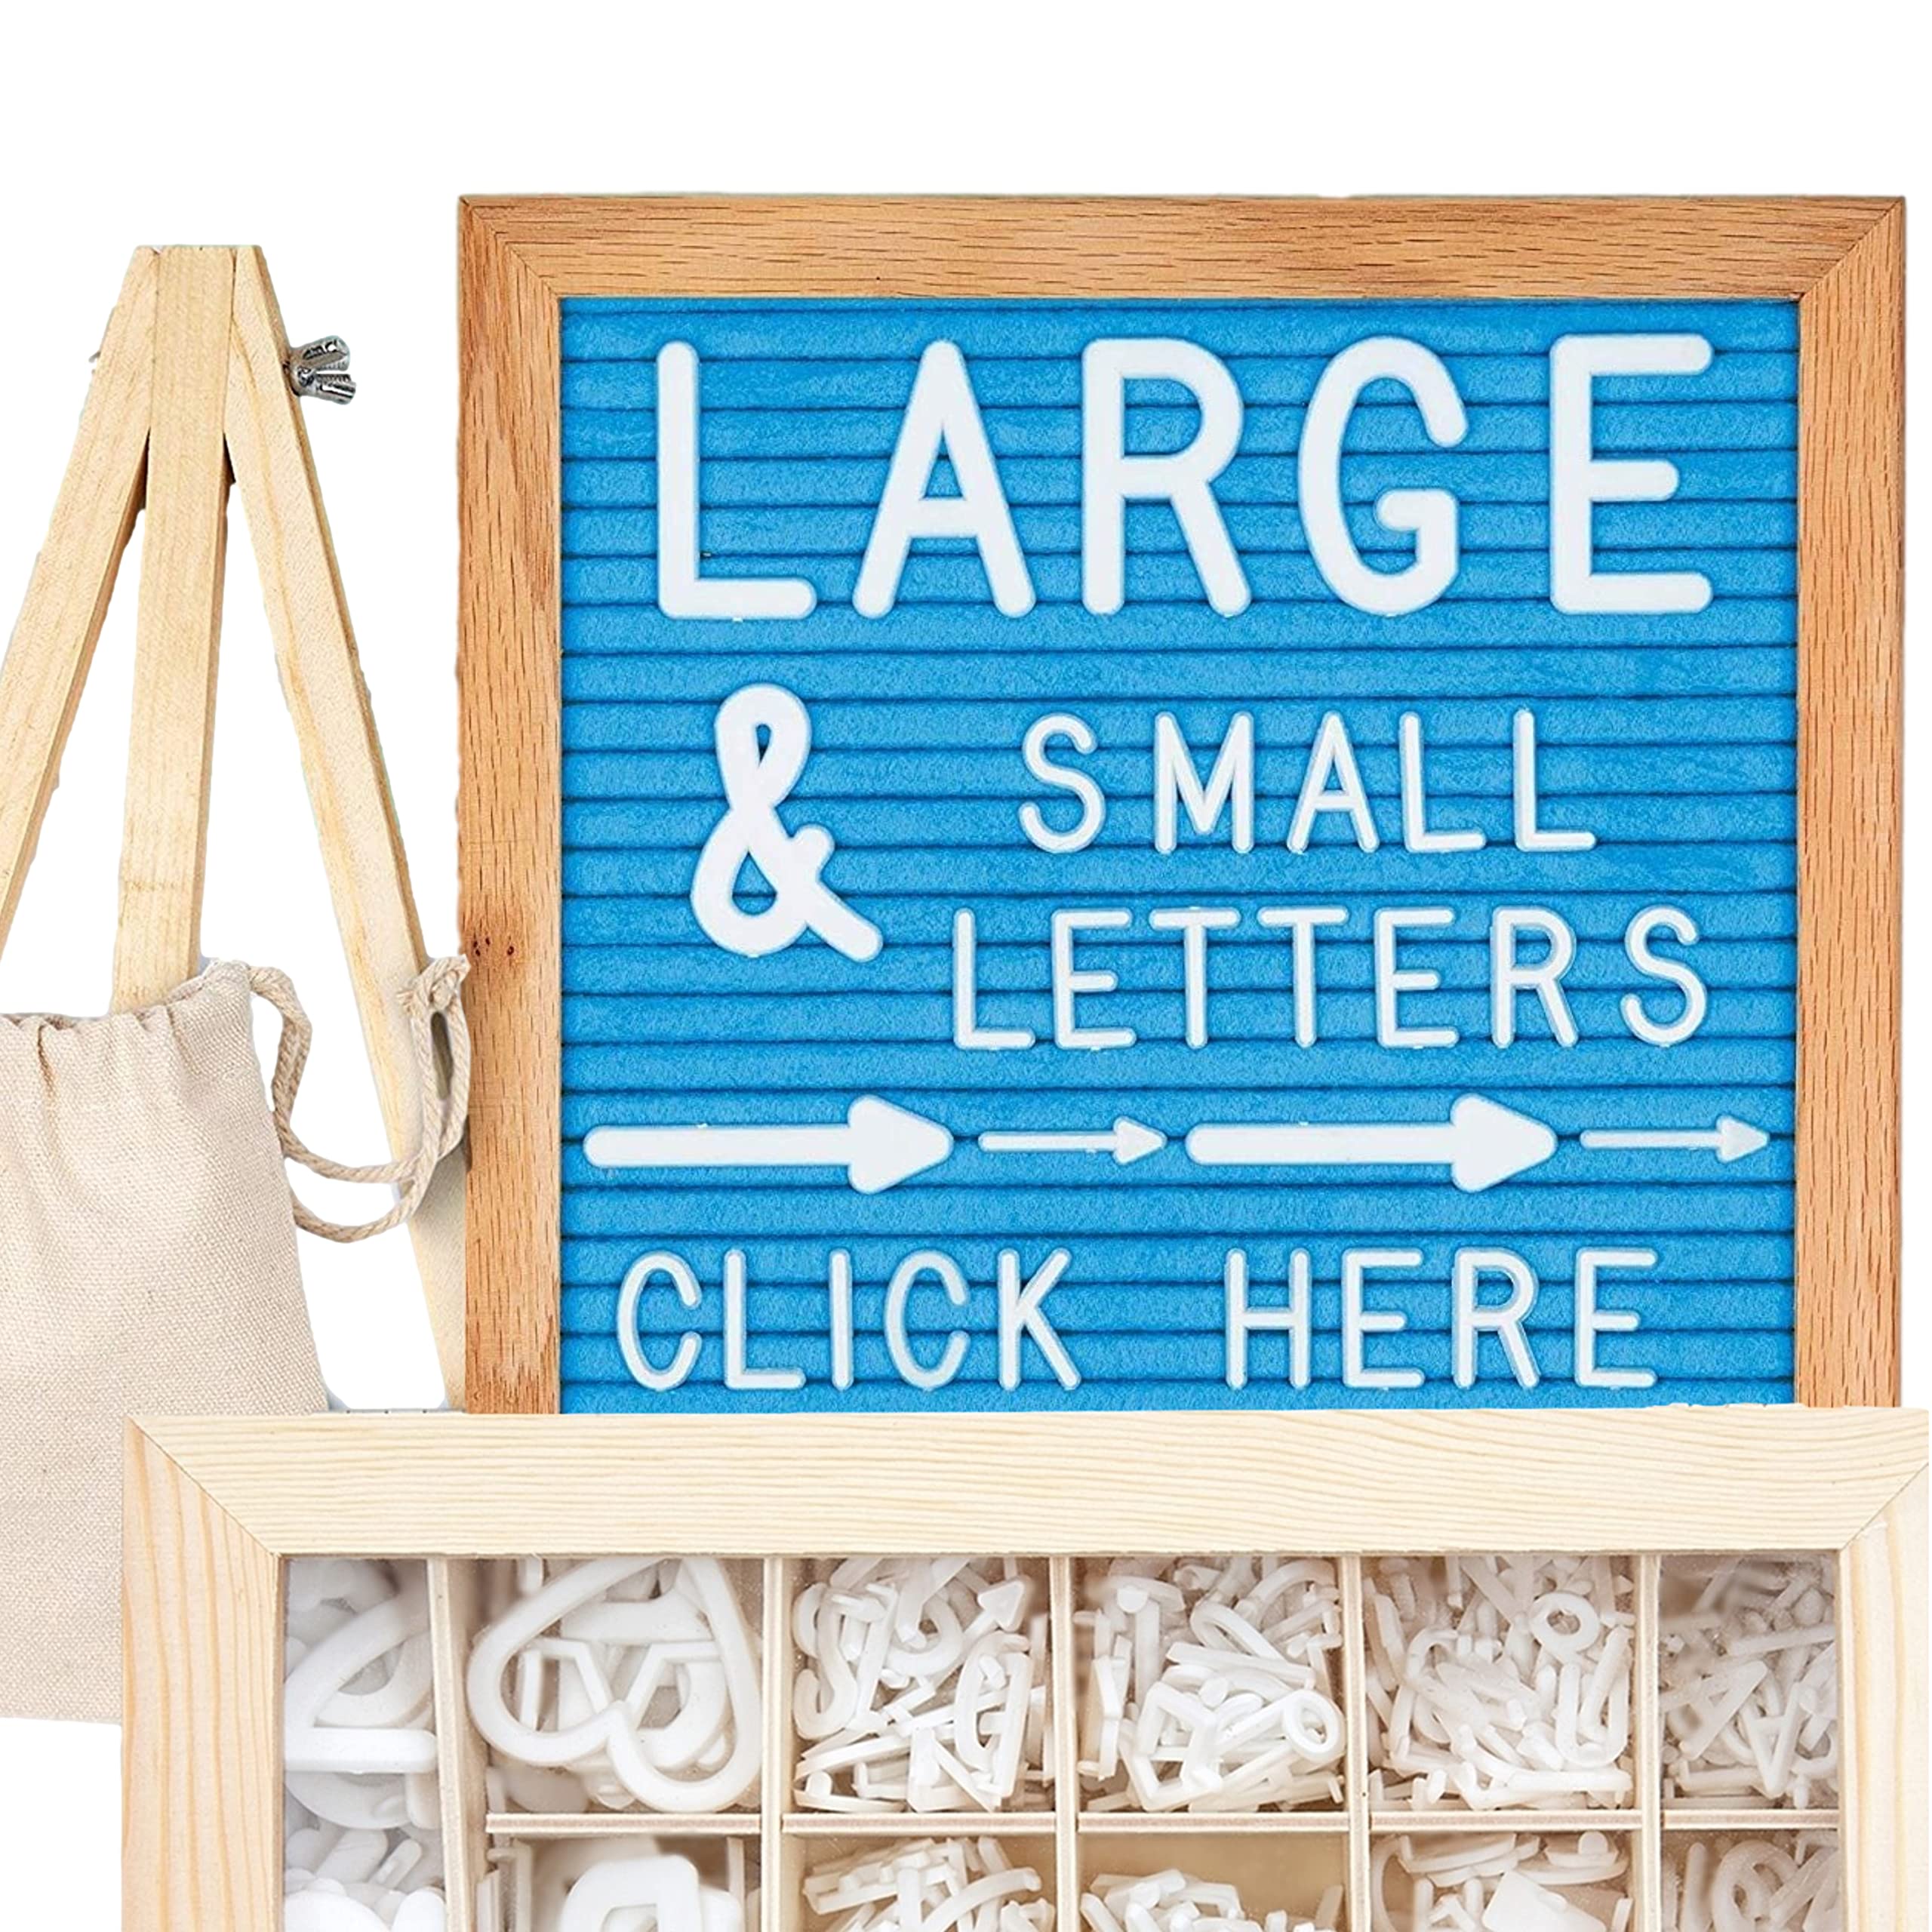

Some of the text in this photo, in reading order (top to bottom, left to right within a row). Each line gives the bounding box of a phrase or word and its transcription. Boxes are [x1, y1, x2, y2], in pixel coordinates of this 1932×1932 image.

[656, 334, 1716, 620] LARGE
[691, 685, 883, 962] &
[1019, 711, 1596, 855] SMALL
[954, 907, 1707, 1051] LETTERS
[615, 1249, 1657, 1392] CLICK HERE
